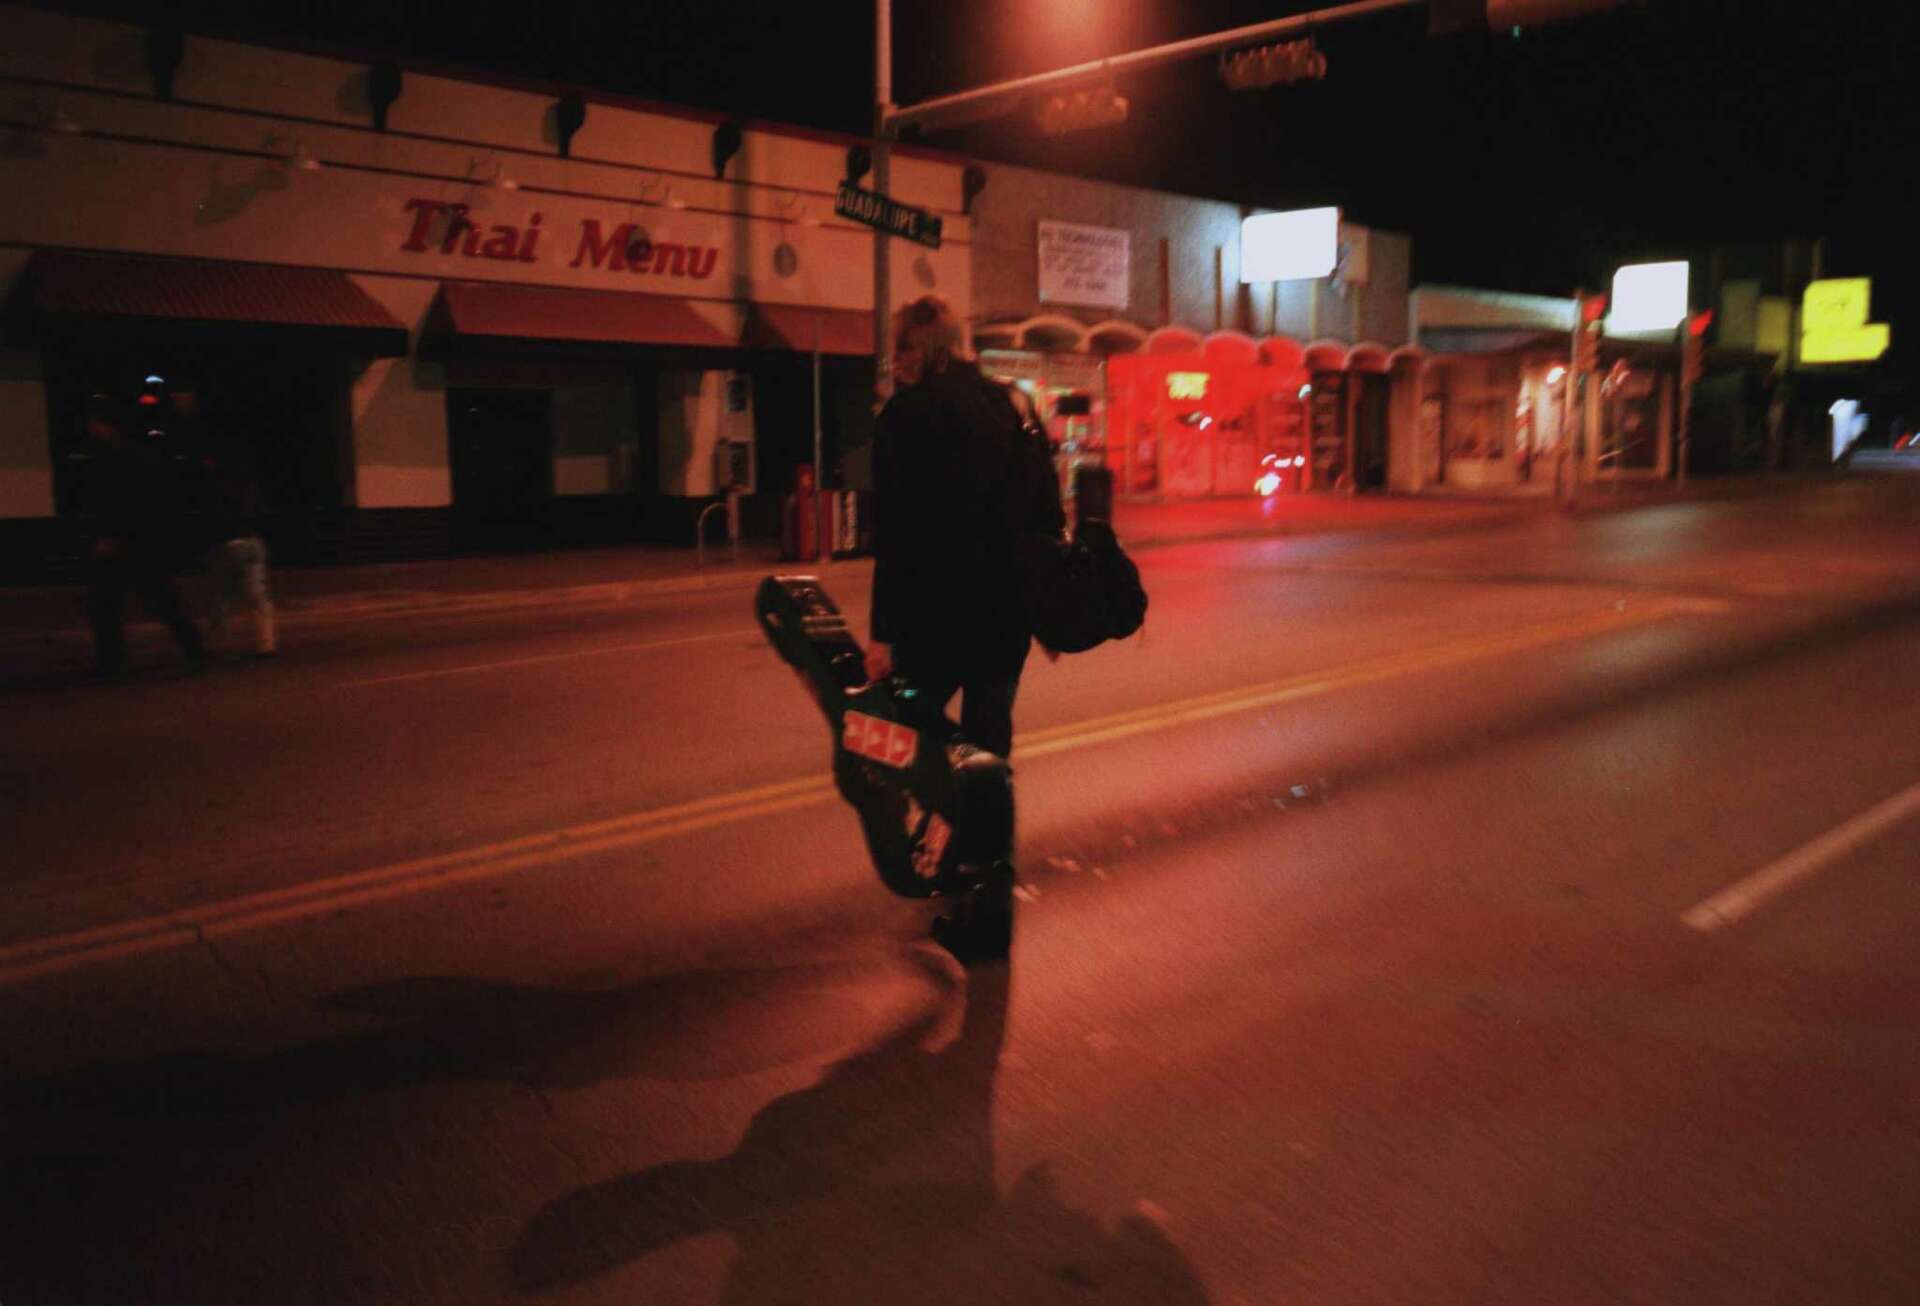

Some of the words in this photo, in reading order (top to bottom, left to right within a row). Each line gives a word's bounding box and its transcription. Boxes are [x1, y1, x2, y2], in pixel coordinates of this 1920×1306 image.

[401, 198, 543, 263] Thai
[570, 219, 718, 279] Menu
[837, 187, 919, 236] GUADALUPE
